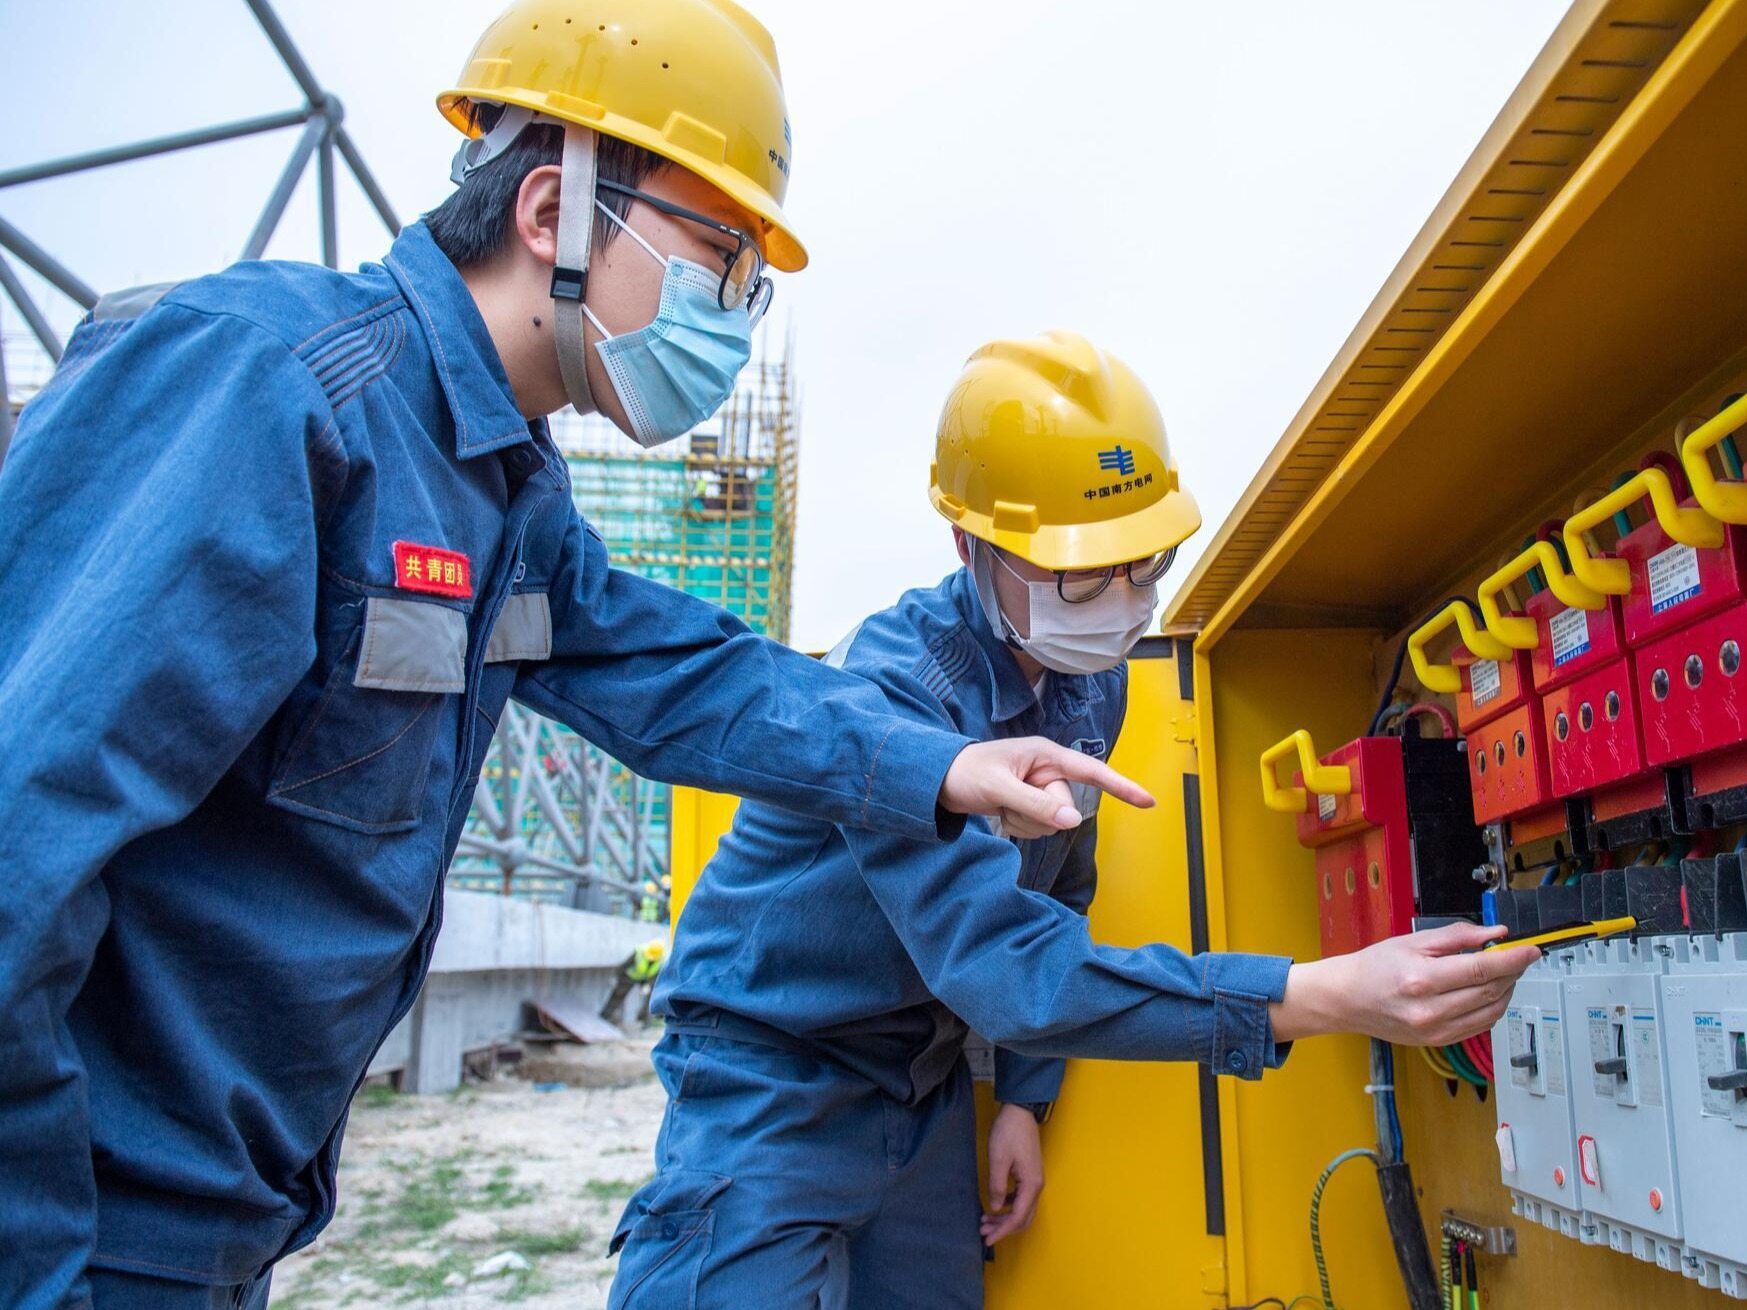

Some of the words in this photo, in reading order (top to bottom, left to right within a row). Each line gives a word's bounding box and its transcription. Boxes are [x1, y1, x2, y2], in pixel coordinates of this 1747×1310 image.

[1084, 473, 1153, 500] 中国南方电网
[406, 554, 463, 586] 共青团员
